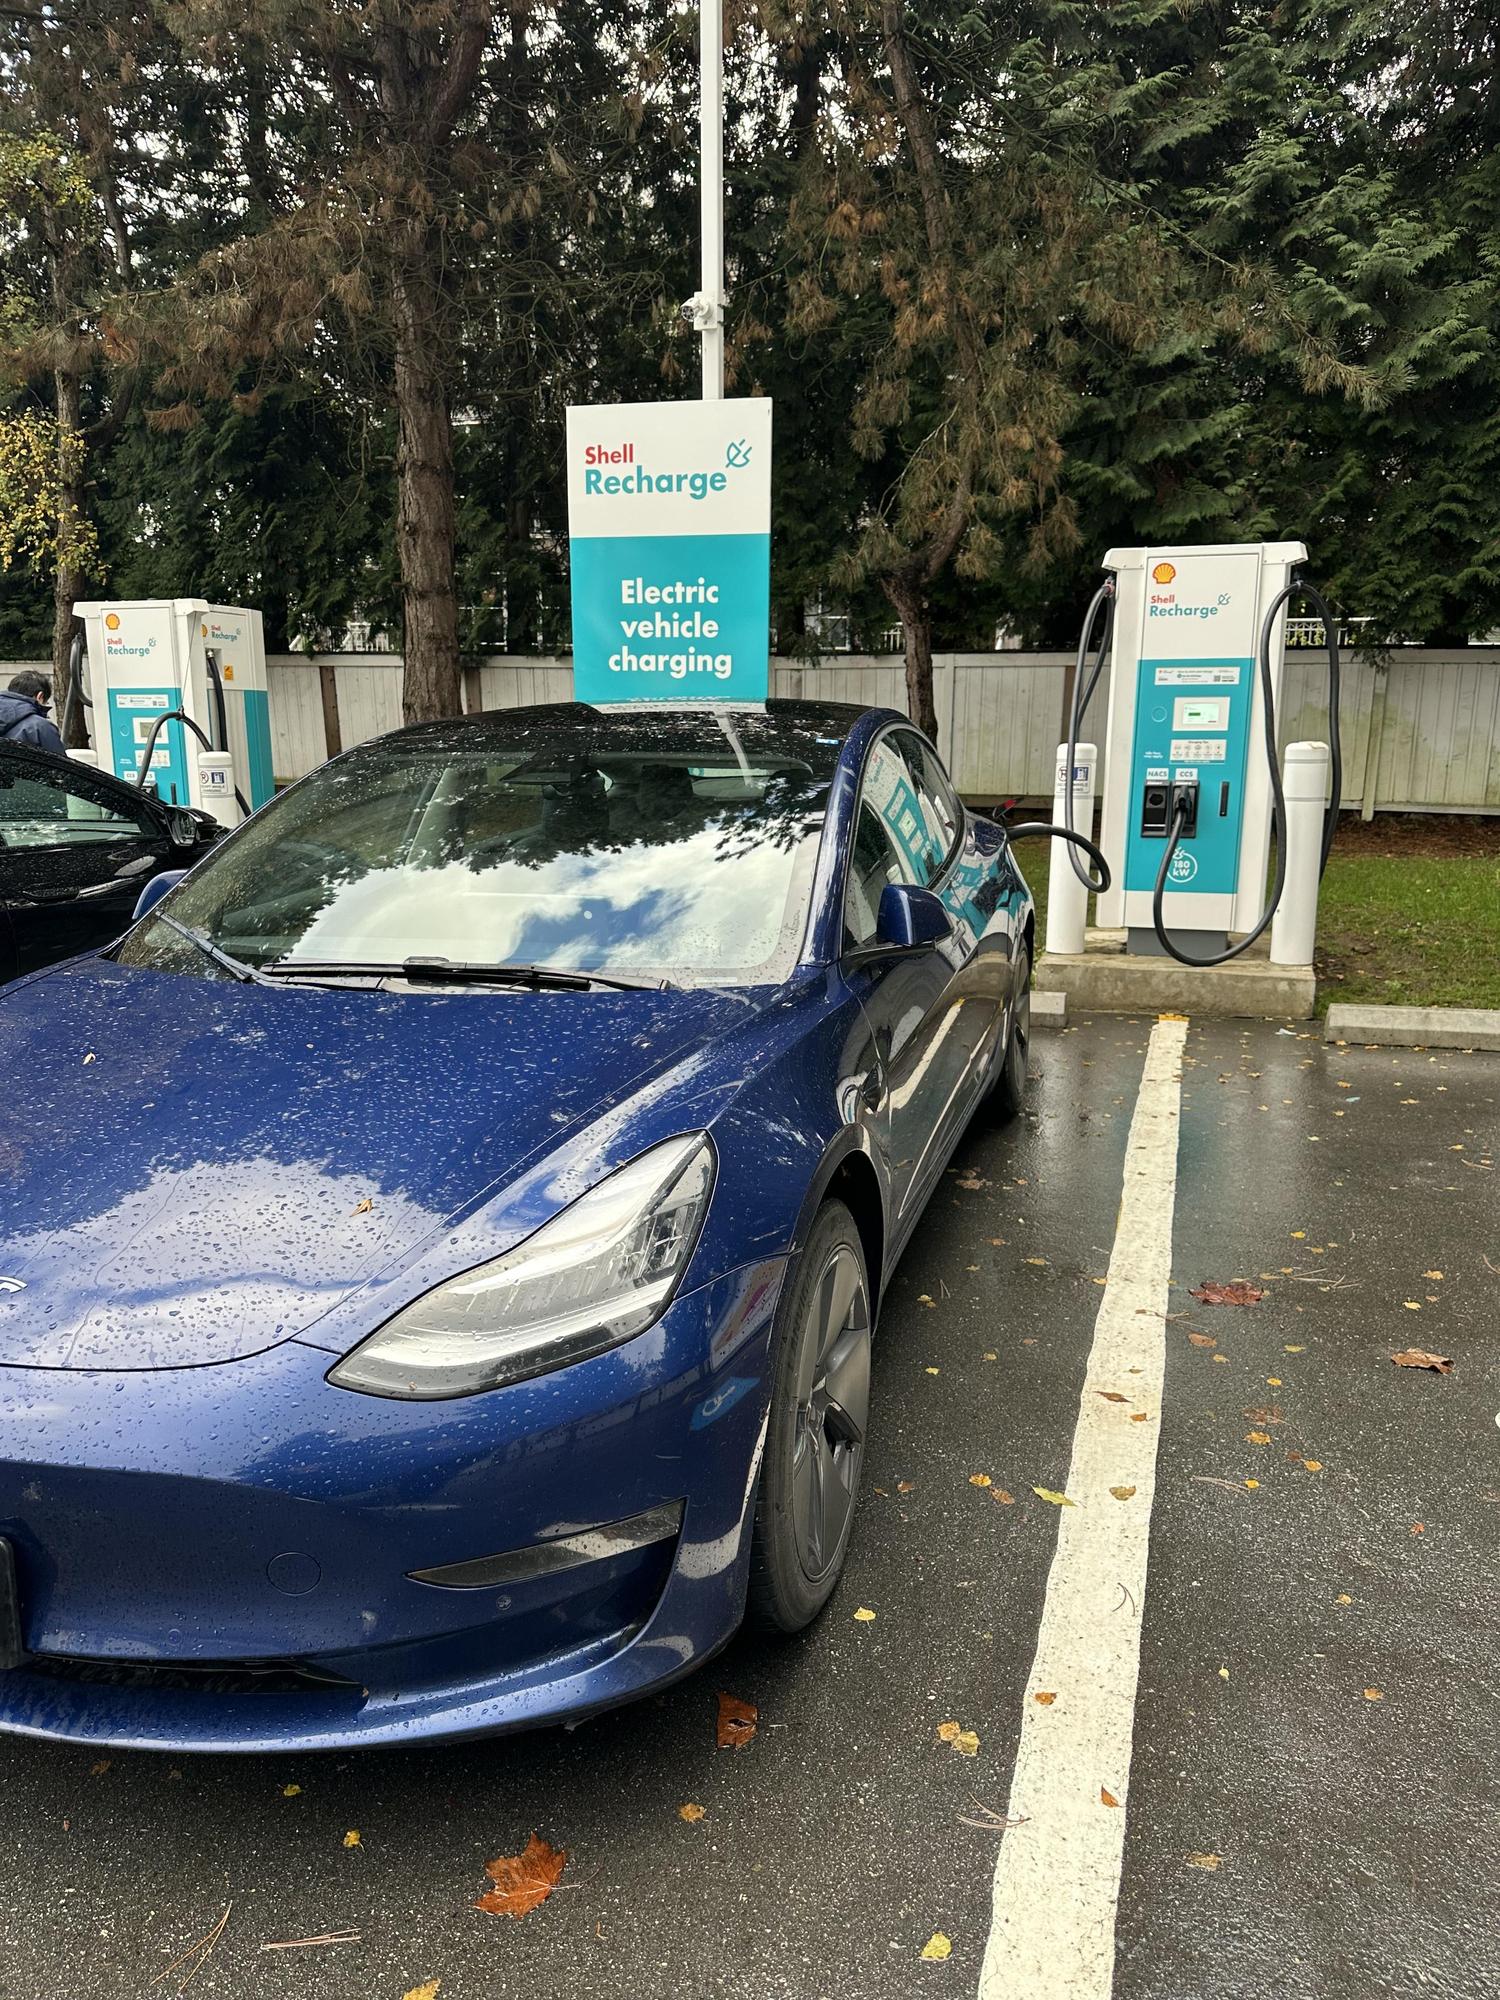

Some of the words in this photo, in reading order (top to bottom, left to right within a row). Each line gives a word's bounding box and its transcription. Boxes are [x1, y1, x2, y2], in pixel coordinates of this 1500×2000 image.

[585, 443, 634, 465] Shell
[585, 465, 727, 500] Recharge
[621, 577, 719, 604] Electric
[1151, 594, 1175, 604] Shell
[1150, 604, 1218, 619] Recharge
[620, 611, 719, 638] vehicle
[211, 631, 238, 641] Recharge
[107, 645, 150, 657] Recharge
[608, 646, 732, 679] charging
[1173, 860, 1190, 868] 180
[1172, 867, 1190, 877] kW
